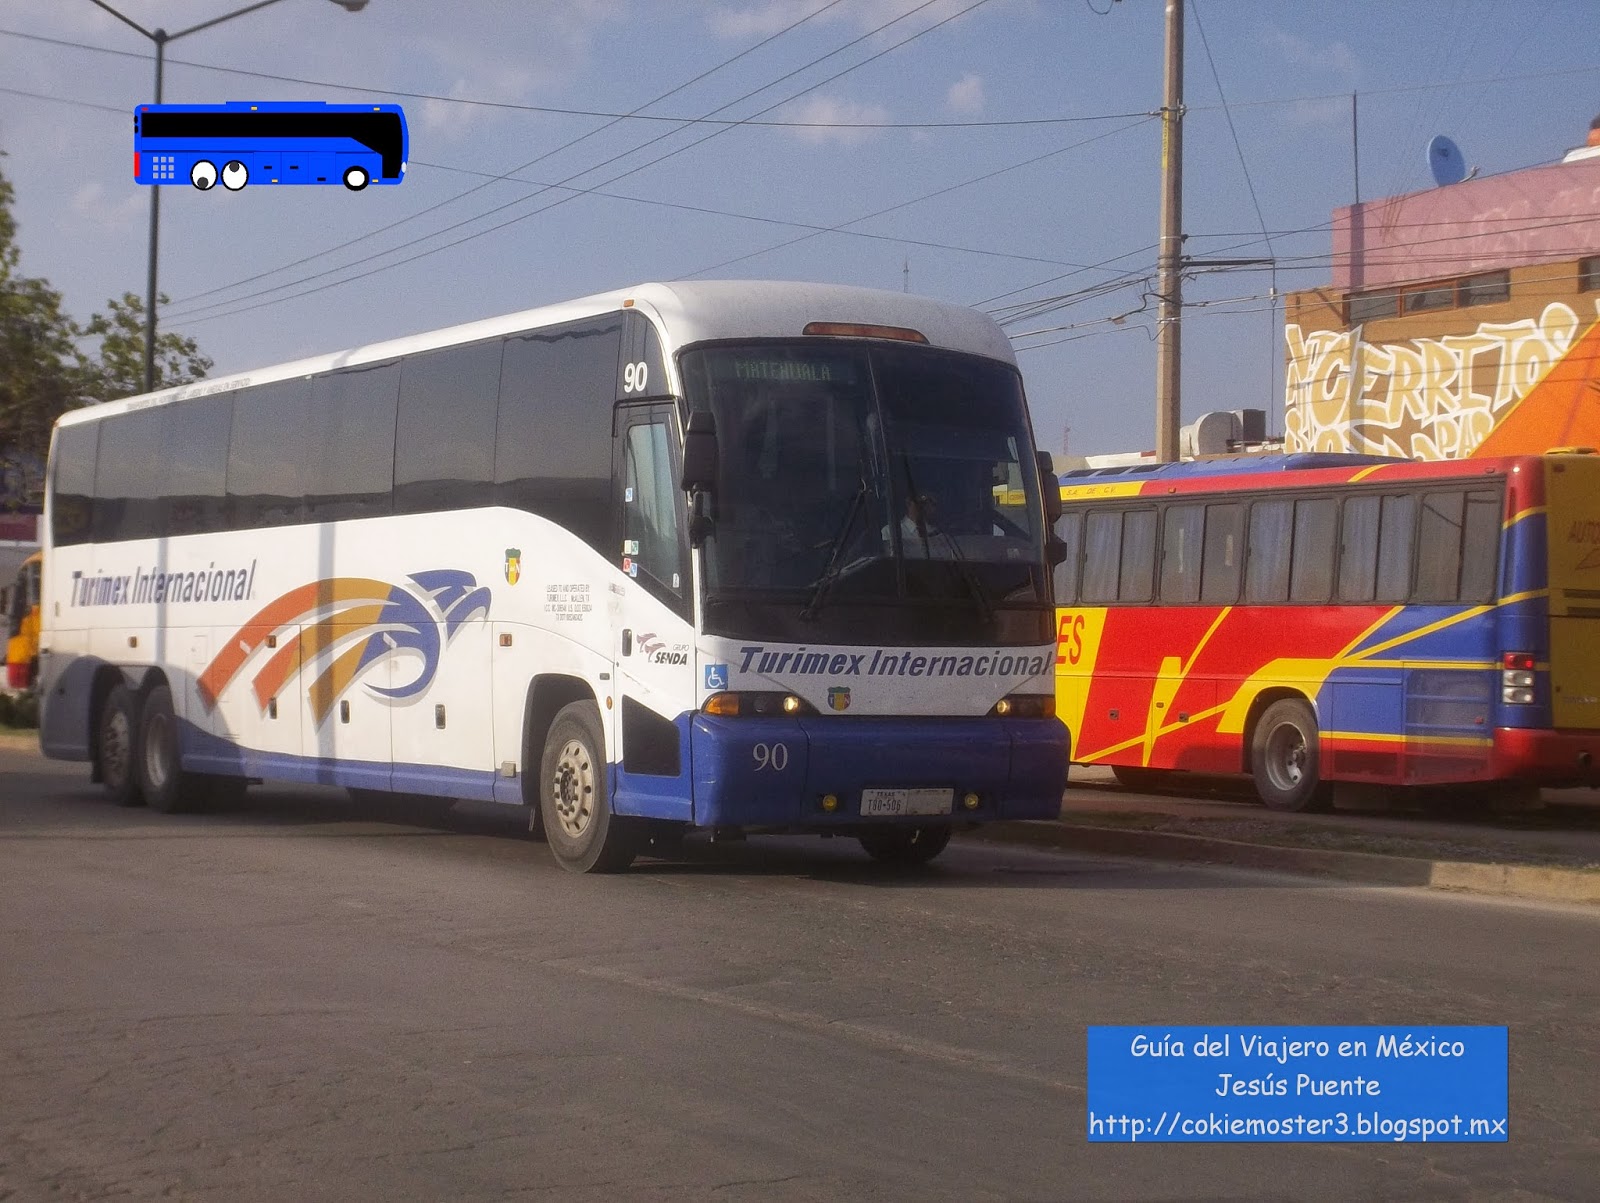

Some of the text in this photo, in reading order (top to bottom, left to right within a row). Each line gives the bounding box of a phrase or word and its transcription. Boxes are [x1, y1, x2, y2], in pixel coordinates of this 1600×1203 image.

[624, 361, 648, 393] 90
[70, 558, 257, 608] Turimex Internacional
[654, 651, 688, 666] SENDA
[740, 646, 1052, 678] Turimex Internacional
[752, 742, 789, 772] 90
